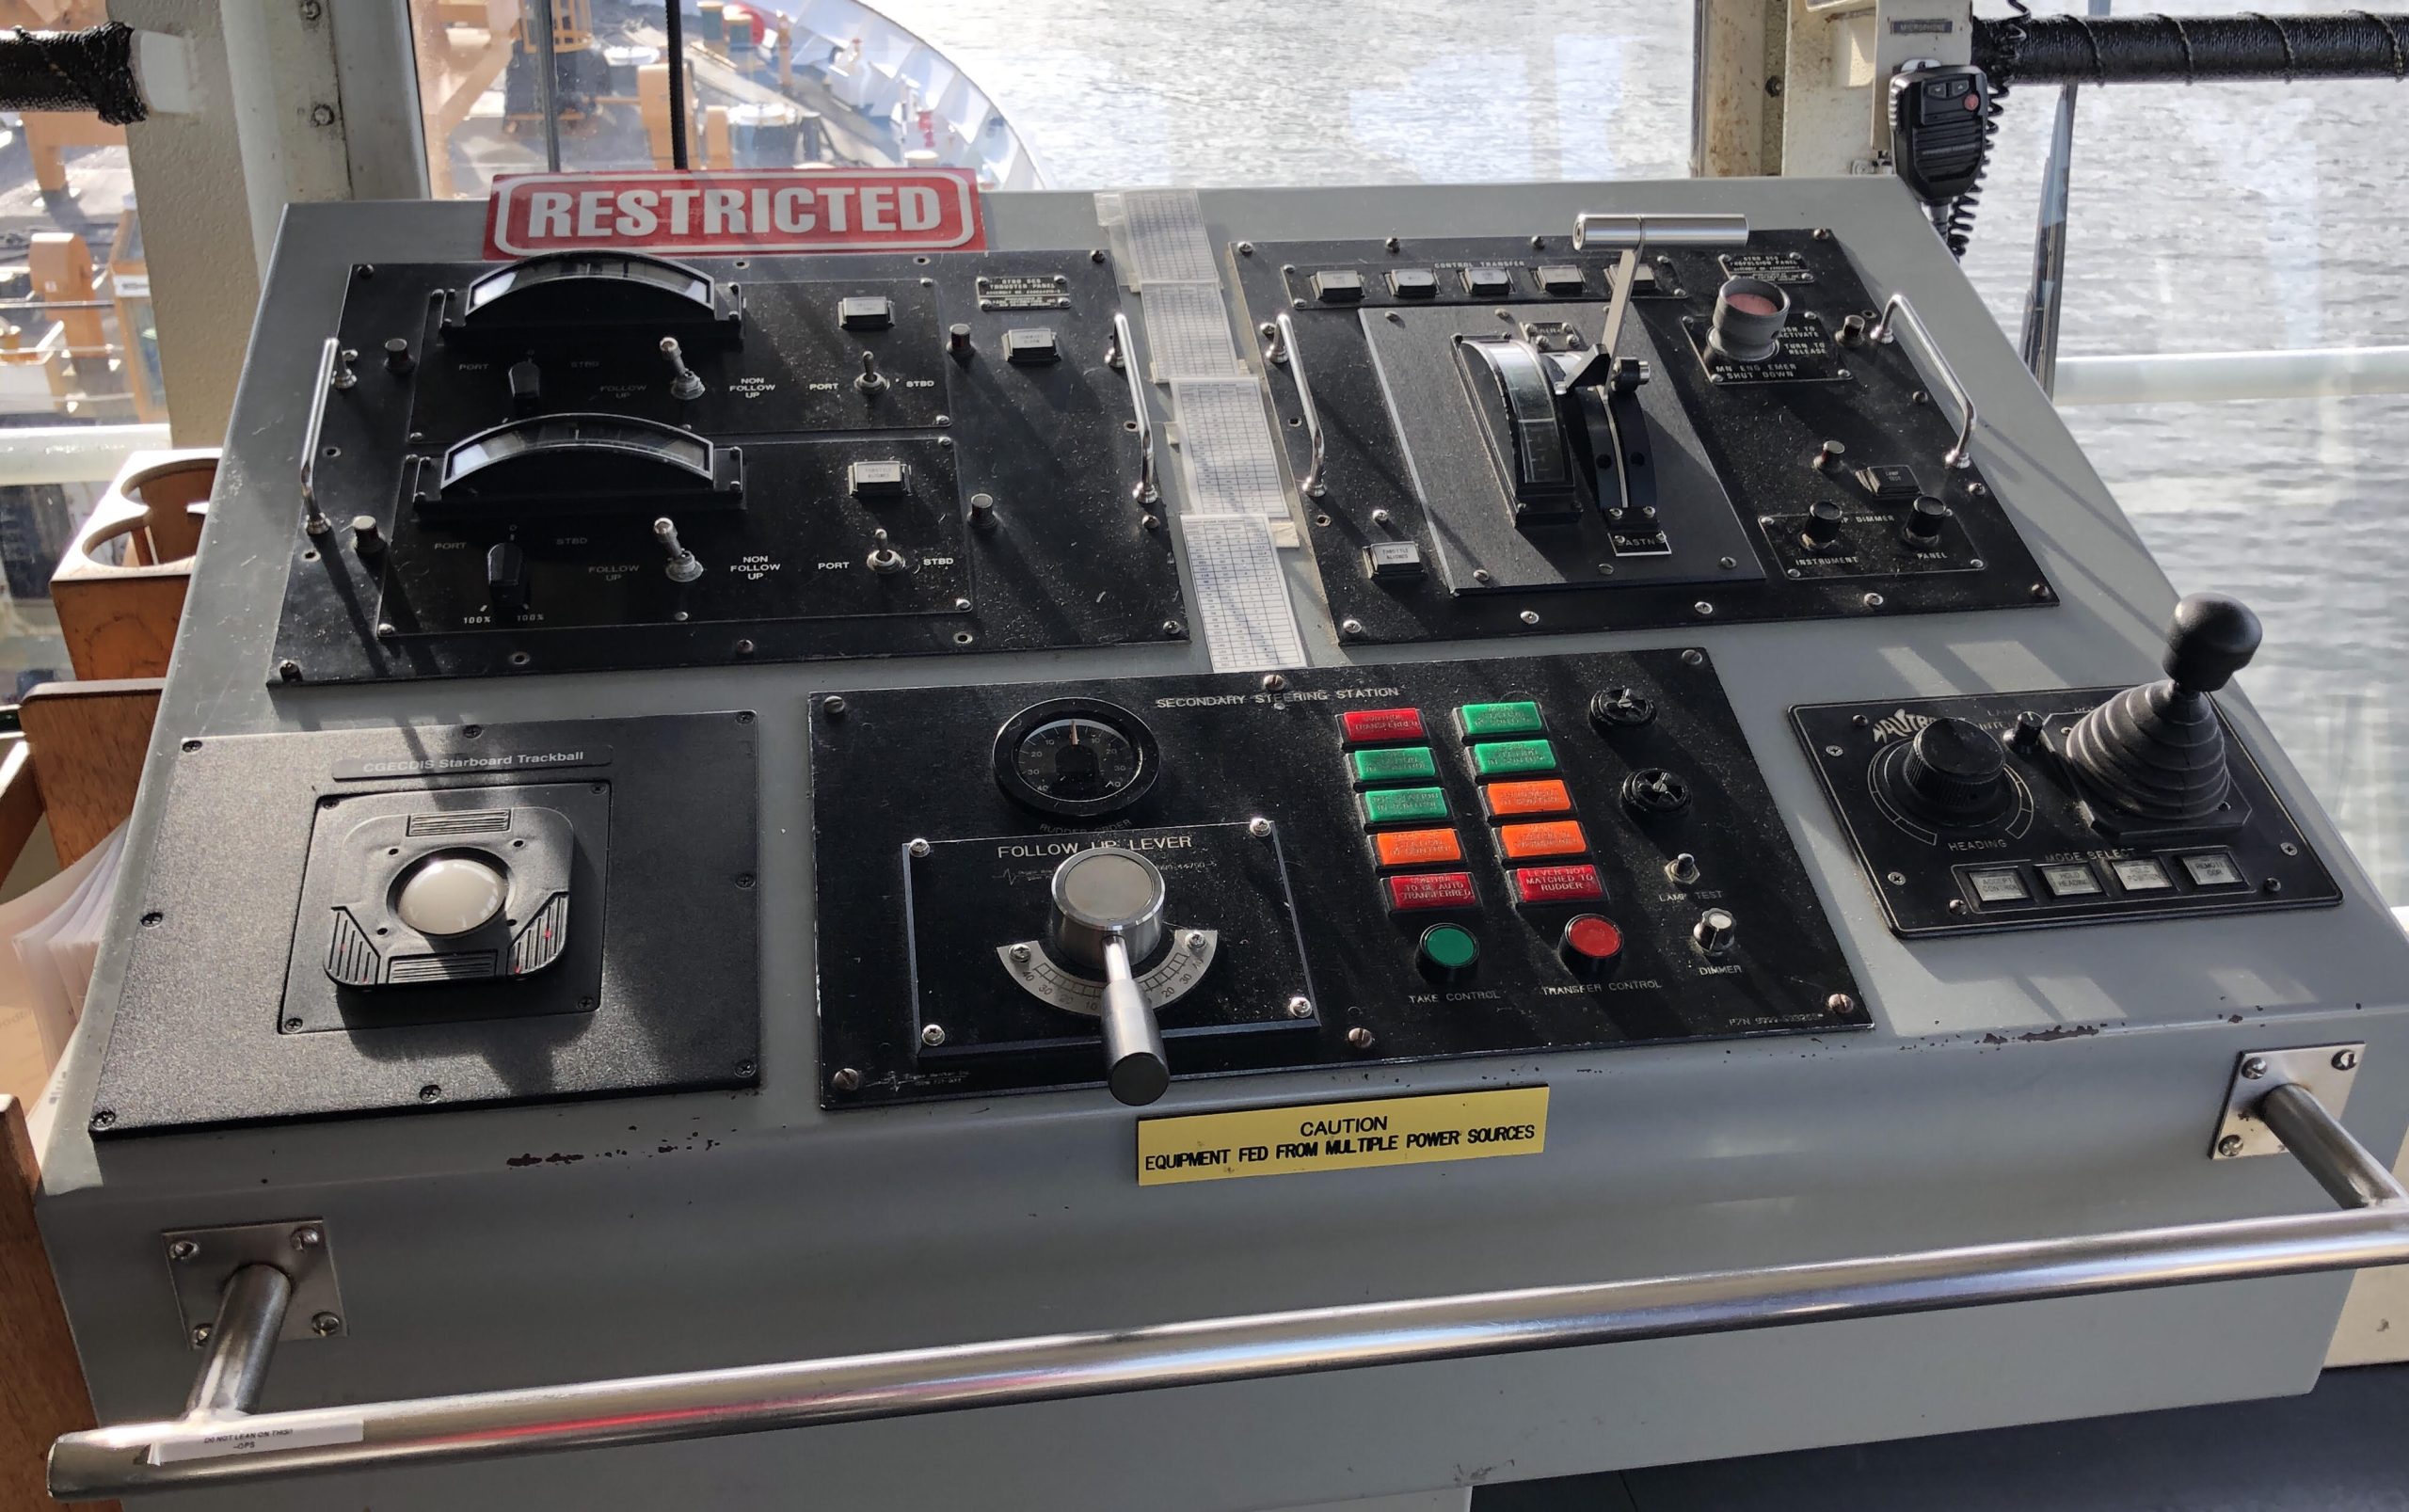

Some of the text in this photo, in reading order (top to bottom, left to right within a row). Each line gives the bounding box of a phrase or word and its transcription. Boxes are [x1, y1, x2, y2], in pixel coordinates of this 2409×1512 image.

[528, 185, 942, 238] RESTRICTED
[458, 363, 489, 372] PORT
[1726, 370, 1795, 380] SHUT DOWN
[741, 377, 765, 386] NON
[809, 382, 839, 391] PORT
[906, 379, 935, 389] STBD
[600, 384, 647, 392] FOLLOW
[728, 384, 775, 392] FOLLOW
[615, 391, 630, 400] UP
[1856, 515, 1895, 523] DIMMER
[434, 542, 468, 550] PORT
[556, 536, 588, 546] STBD
[742, 555, 769, 564] NON
[923, 557, 954, 566] STBD
[1795, 555, 1859, 566] INSTRUMENT
[1916, 552, 1949, 561] PANEL
[588, 565, 640, 574] FOLLOW
[730, 563, 781, 573] FOLLOW
[818, 562, 850, 570] PORT
[605, 573, 622, 581] UP
[747, 572, 764, 581] UP
[463, 615, 491, 625] 100%
[1156, 687, 1400, 709] SECONDARY STEERING STATION
[363, 751, 584, 773] CGECDIS Starboard Trackball
[997, 836, 1192, 858] FOLLOW UP LEVER
[1947, 838, 2007, 851] HEADING
[2045, 848, 2135, 863] MODE SELECT
[1527, 867, 1587, 877] LEVER NOT
[1525, 875, 1575, 885] MATCHED
[1439, 881, 1464, 890] AUTO
[1540, 883, 1584, 891] RUDDER
[1403, 889, 1472, 899] TRANSFERRED
[1658, 890, 1723, 902] LAMP TEST
[1699, 964, 1743, 976] DIMMER
[1022, 970, 1035, 982] 40
[1179, 972, 1192, 985] 30
[1038, 984, 1053, 997] 30
[1161, 986, 1175, 998] 20
[1542, 979, 1663, 995] TRANSFER CONTROL
[1059, 993, 1074, 1005] 20
[1409, 989, 1502, 1004] TAKE CONTROL
[1300, 1115, 1389, 1138] CAUTION
[1145, 1124, 1535, 1171] EQUIPMENT FED FROM MULTIPLE POWER SOURCES
[216, 1435, 232, 1443] NOT
[234, 1432, 256, 1441] LEAN
